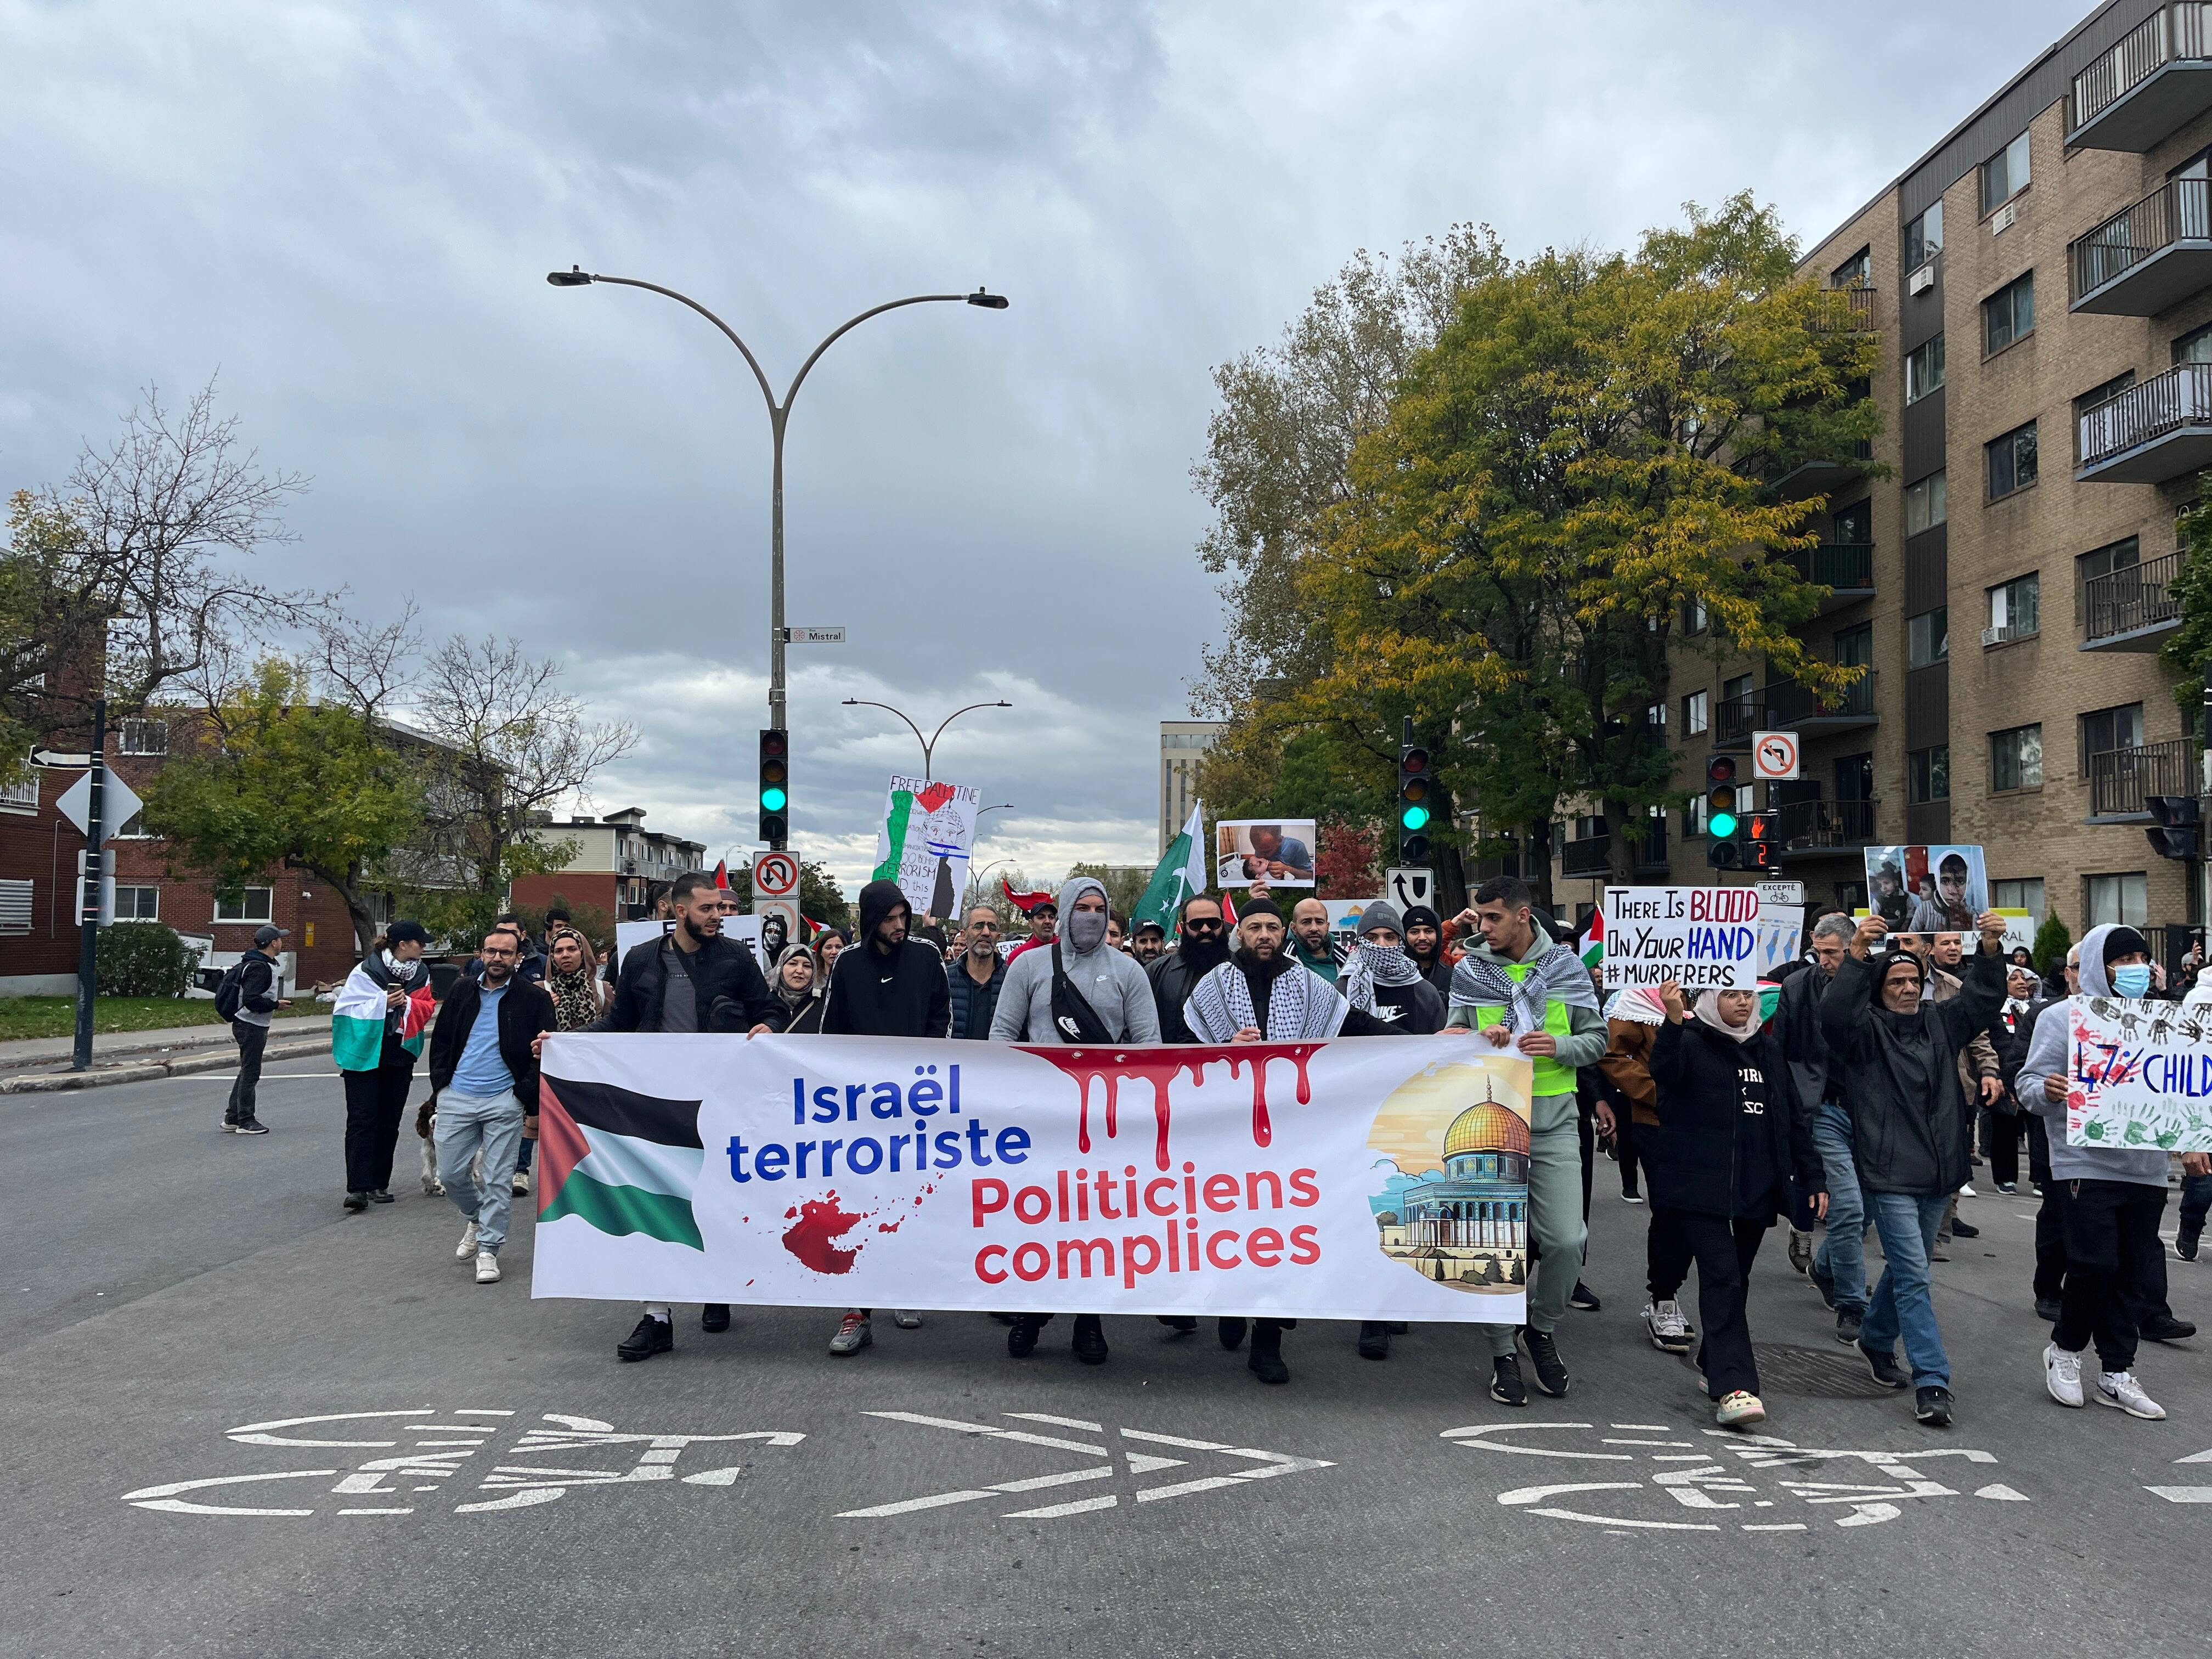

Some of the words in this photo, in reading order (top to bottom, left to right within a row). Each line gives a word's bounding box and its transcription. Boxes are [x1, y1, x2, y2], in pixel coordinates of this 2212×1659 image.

[890, 776, 922, 794] FREE
[924, 781, 980, 805] PALESTINE
[918, 855, 939, 867] BOMBS
[1758, 844, 1766, 864] 2
[881, 861, 936, 881] TERRORISM
[912, 881, 928, 893] this
[1690, 890, 1758, 922] BLOOD
[1688, 927, 1754, 961] HAND
[1064, 1017, 1081, 1034] NIKE
[793, 1064, 961, 1125] Israël
[726, 1119, 1032, 1183] terroriste
[972, 1161, 1320, 1228] Politiciens
[975, 1217, 1321, 1289] complices
